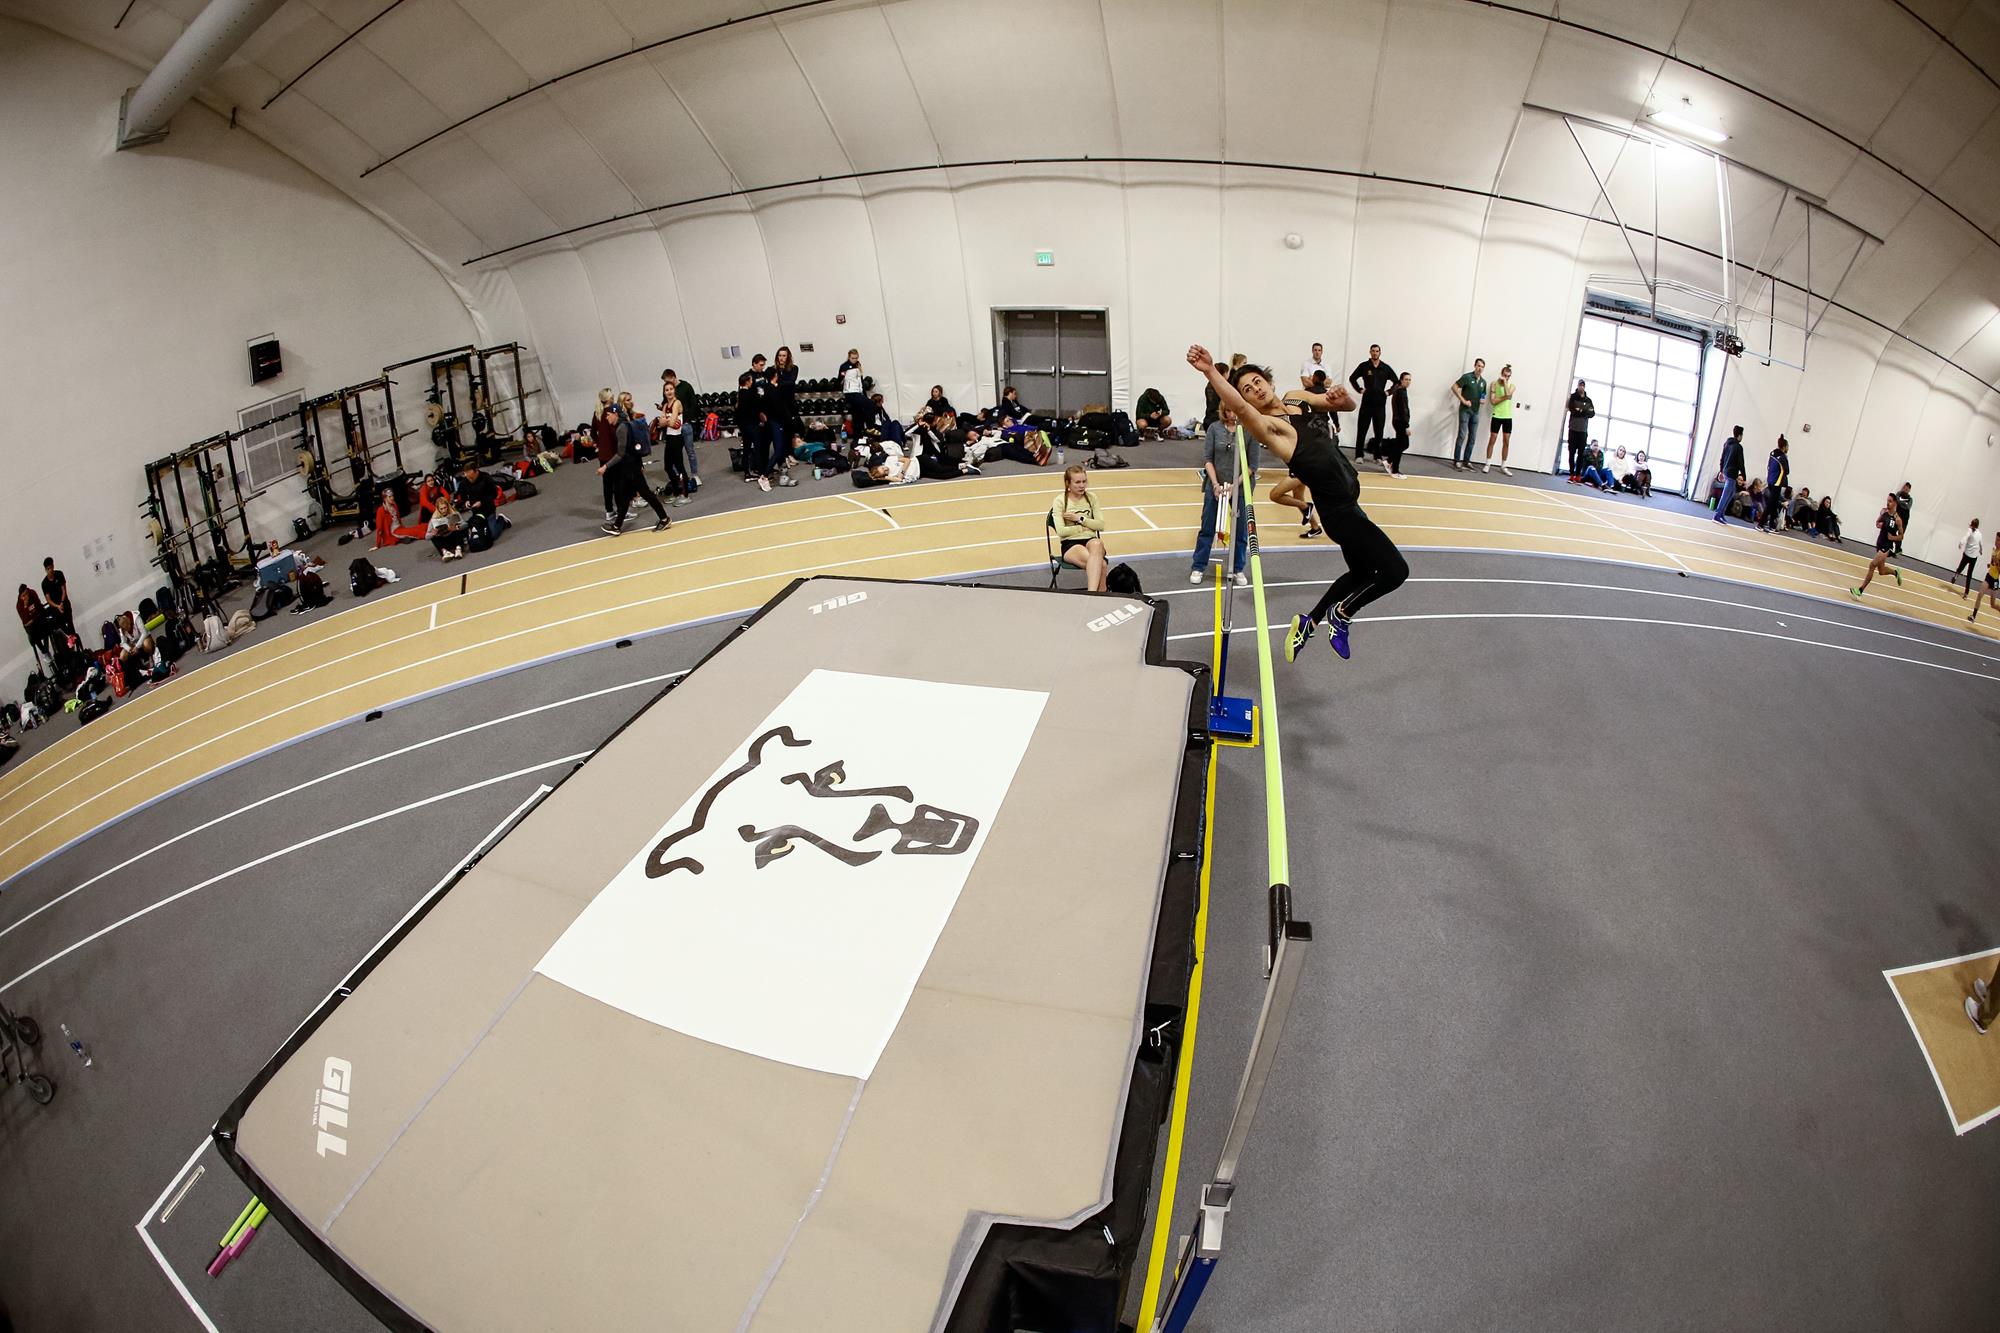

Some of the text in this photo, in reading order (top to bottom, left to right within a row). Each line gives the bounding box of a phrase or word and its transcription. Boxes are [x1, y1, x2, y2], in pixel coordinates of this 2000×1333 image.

[808, 591, 868, 615] GILL
[1086, 603, 1144, 632] GILL
[316, 1056, 352, 1158] GILL
